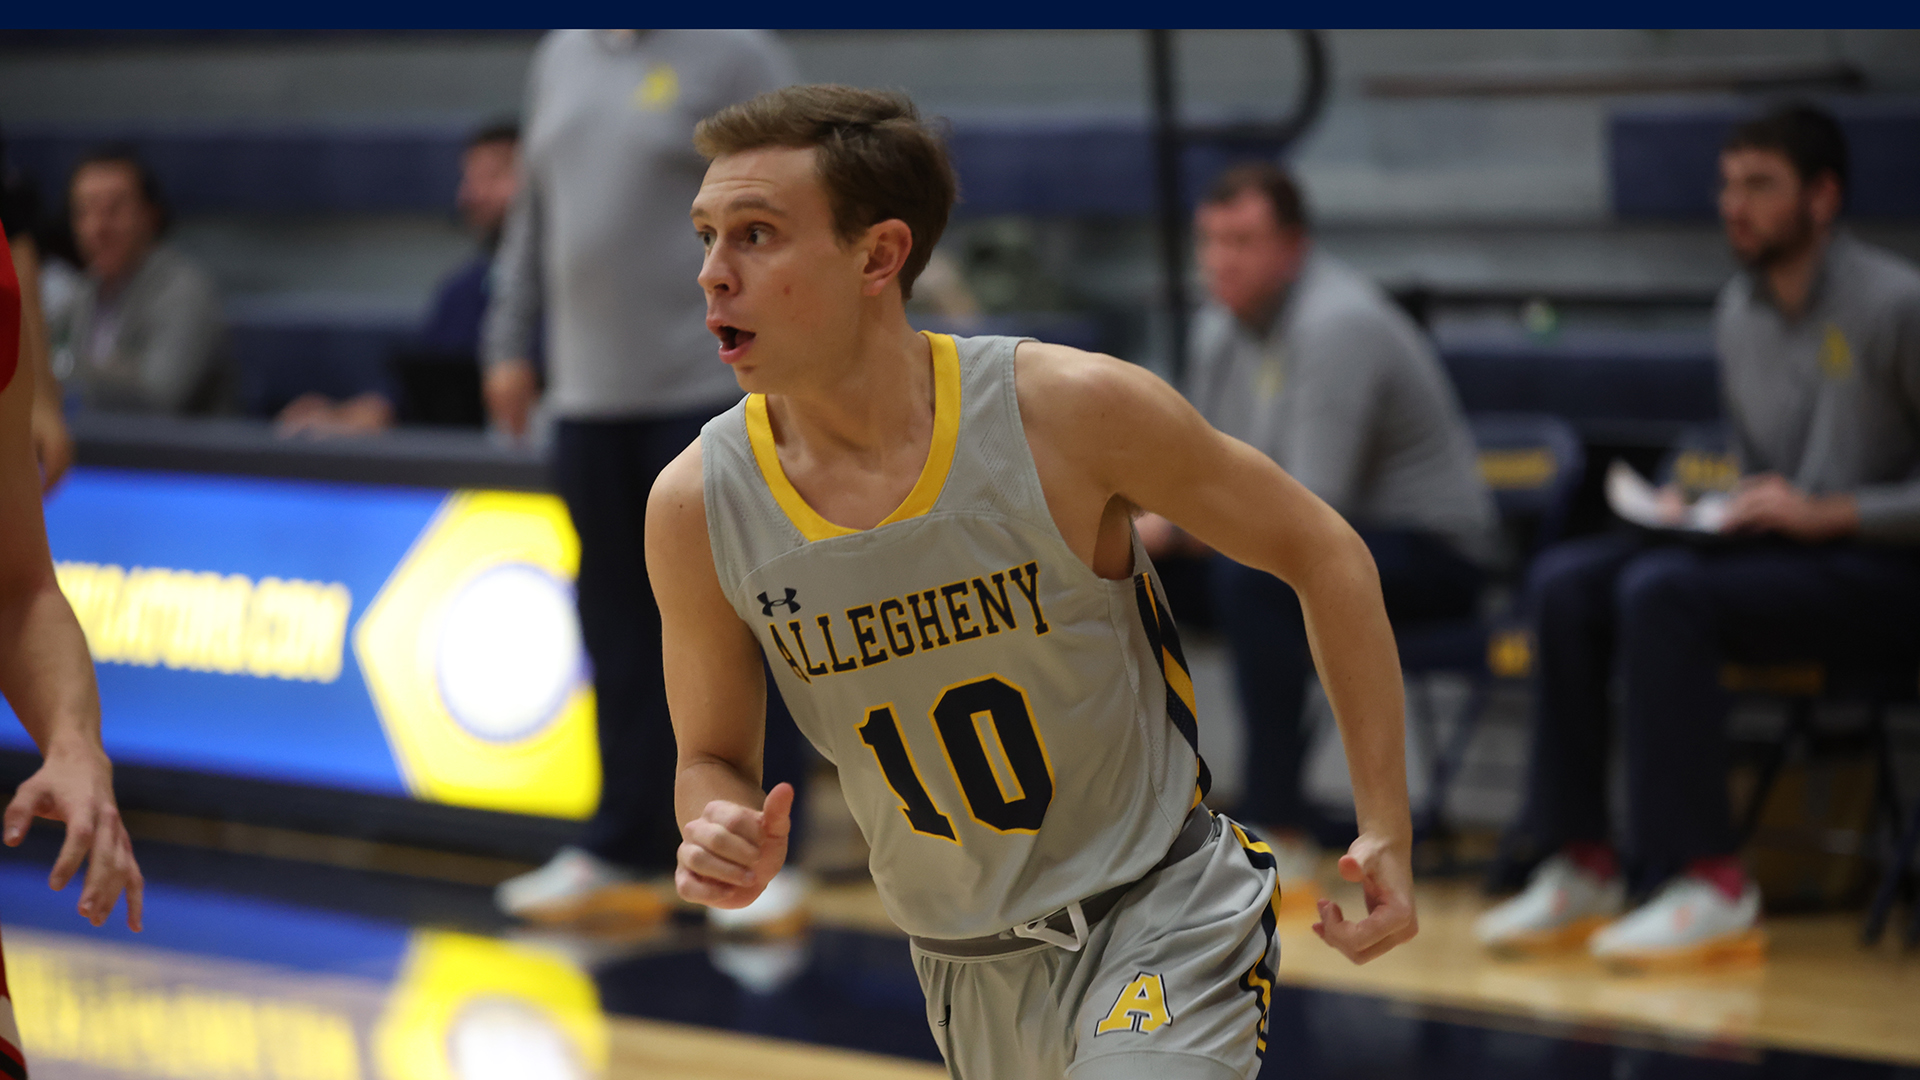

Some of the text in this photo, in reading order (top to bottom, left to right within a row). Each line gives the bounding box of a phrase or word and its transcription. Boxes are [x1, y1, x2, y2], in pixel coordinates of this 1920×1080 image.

[768, 560, 1050, 684] ALLEGHENY
[853, 673, 1056, 847] 10
[1094, 971, 1174, 1038] A
